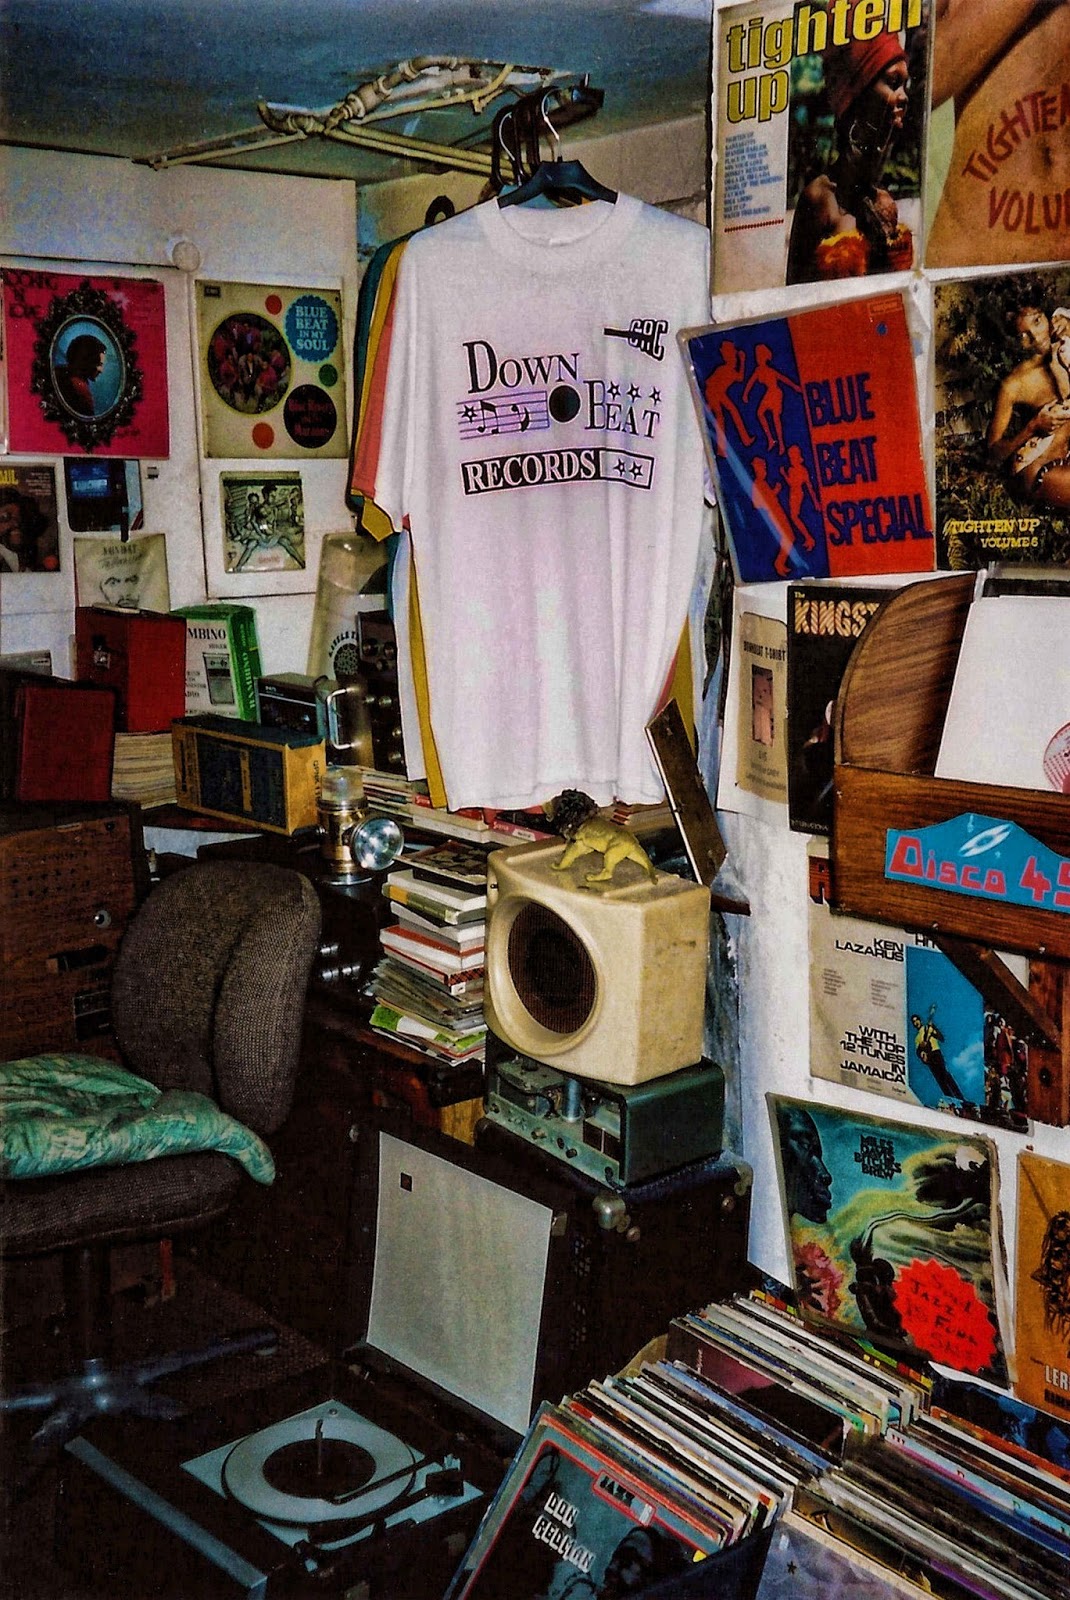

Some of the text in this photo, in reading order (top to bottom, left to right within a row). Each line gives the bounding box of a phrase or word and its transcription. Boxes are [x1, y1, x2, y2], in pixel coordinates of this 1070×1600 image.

[727, 0, 922, 73] tighten
[727, 70, 788, 123] up
[988, 187, 1070, 235] VOLU
[295, 305, 327, 318] BLUE
[295, 318, 329, 330] BEAT
[296, 339, 330, 351] SOUL
[299, 330, 325, 339] IN MY
[462, 340, 580, 394] DOWN
[583, 380, 661, 439] BEAT
[805, 372, 875, 427] BLUE
[464, 450, 597, 493] RECORDS
[815, 435, 878, 487] BEAT
[826, 493, 934, 546] SPECIAL
[950, 518, 1041, 534] TIGHTEN UP
[980, 537, 1030, 548] VOLUME
[888, 835, 1007, 895] Disco
[835, 940, 905, 963] LAZARUS
[873, 938, 904, 951] KEN
[845, 1031, 905, 1054] THE TOP
[859, 1025, 896, 1044] WITH
[840, 1040, 905, 1065] 12 TUNES
[840, 1060, 906, 1085] JAMAICA
[891, 1063, 906, 1076] IN
[1045, 1365, 1070, 1391] LER
[543, 1492, 579, 1528] DON
[532, 1514, 597, 1573] REDMAN
